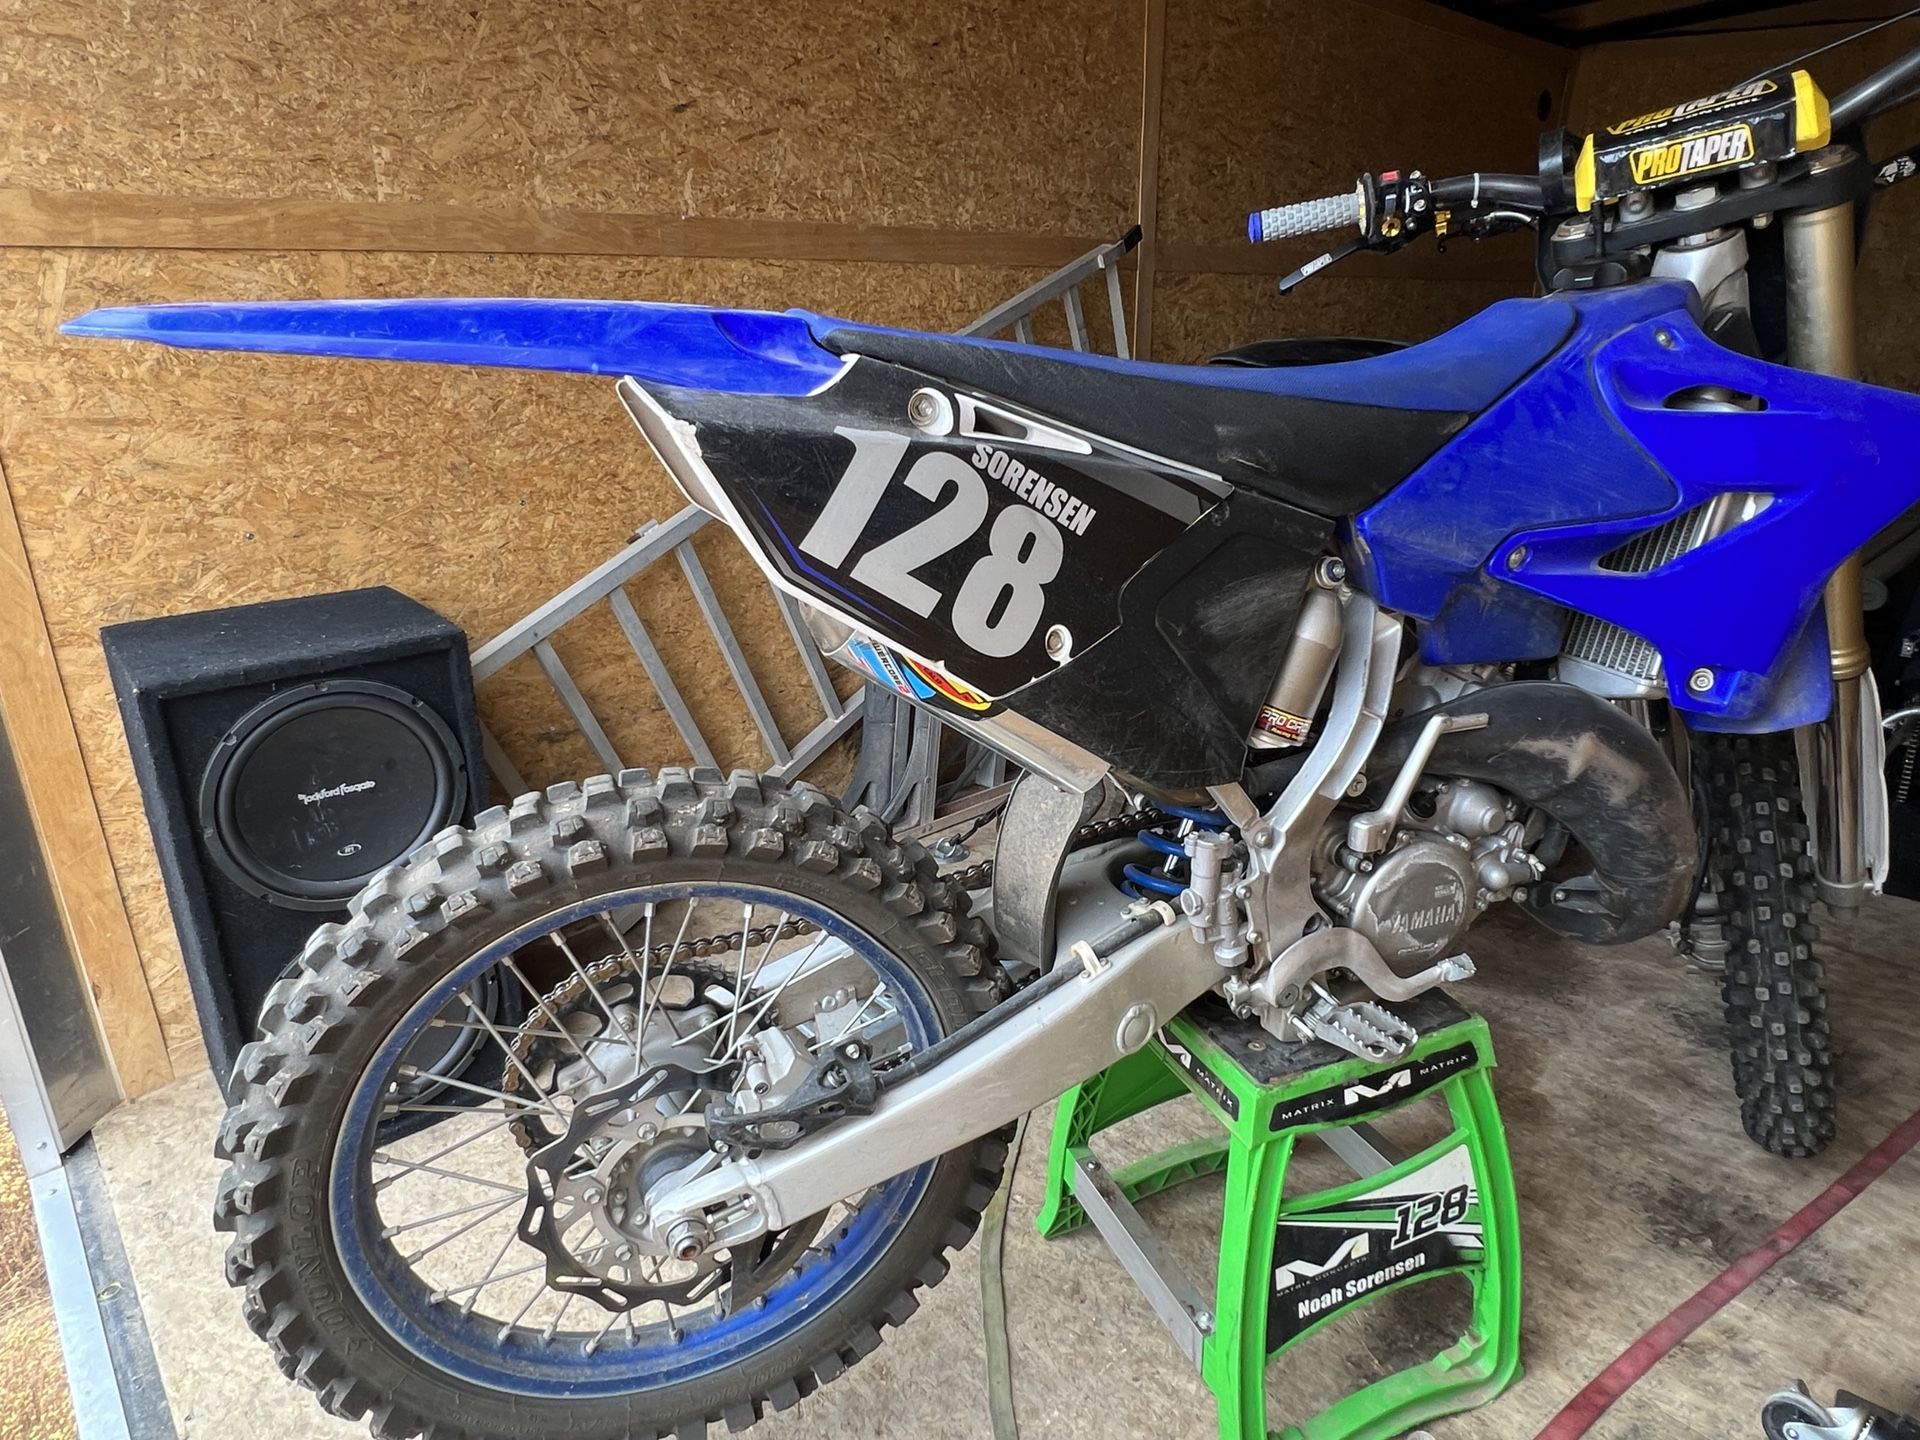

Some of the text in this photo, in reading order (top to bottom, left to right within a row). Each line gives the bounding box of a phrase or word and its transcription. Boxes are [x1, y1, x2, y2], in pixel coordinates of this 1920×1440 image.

[1637, 129, 1748, 183] PROTAPER
[971, 443, 1097, 537] SORENSEN
[798, 425, 1064, 658] 128
[1260, 709, 1288, 727] PRO
[1391, 903, 1456, 934] YAMAHA
[1281, 1098, 1335, 1120] MATRIX
[1419, 1054, 1469, 1076] MATRIX
[1391, 1184, 1470, 1250] 128
[1298, 1252, 1426, 1319] Noah Sorensen
